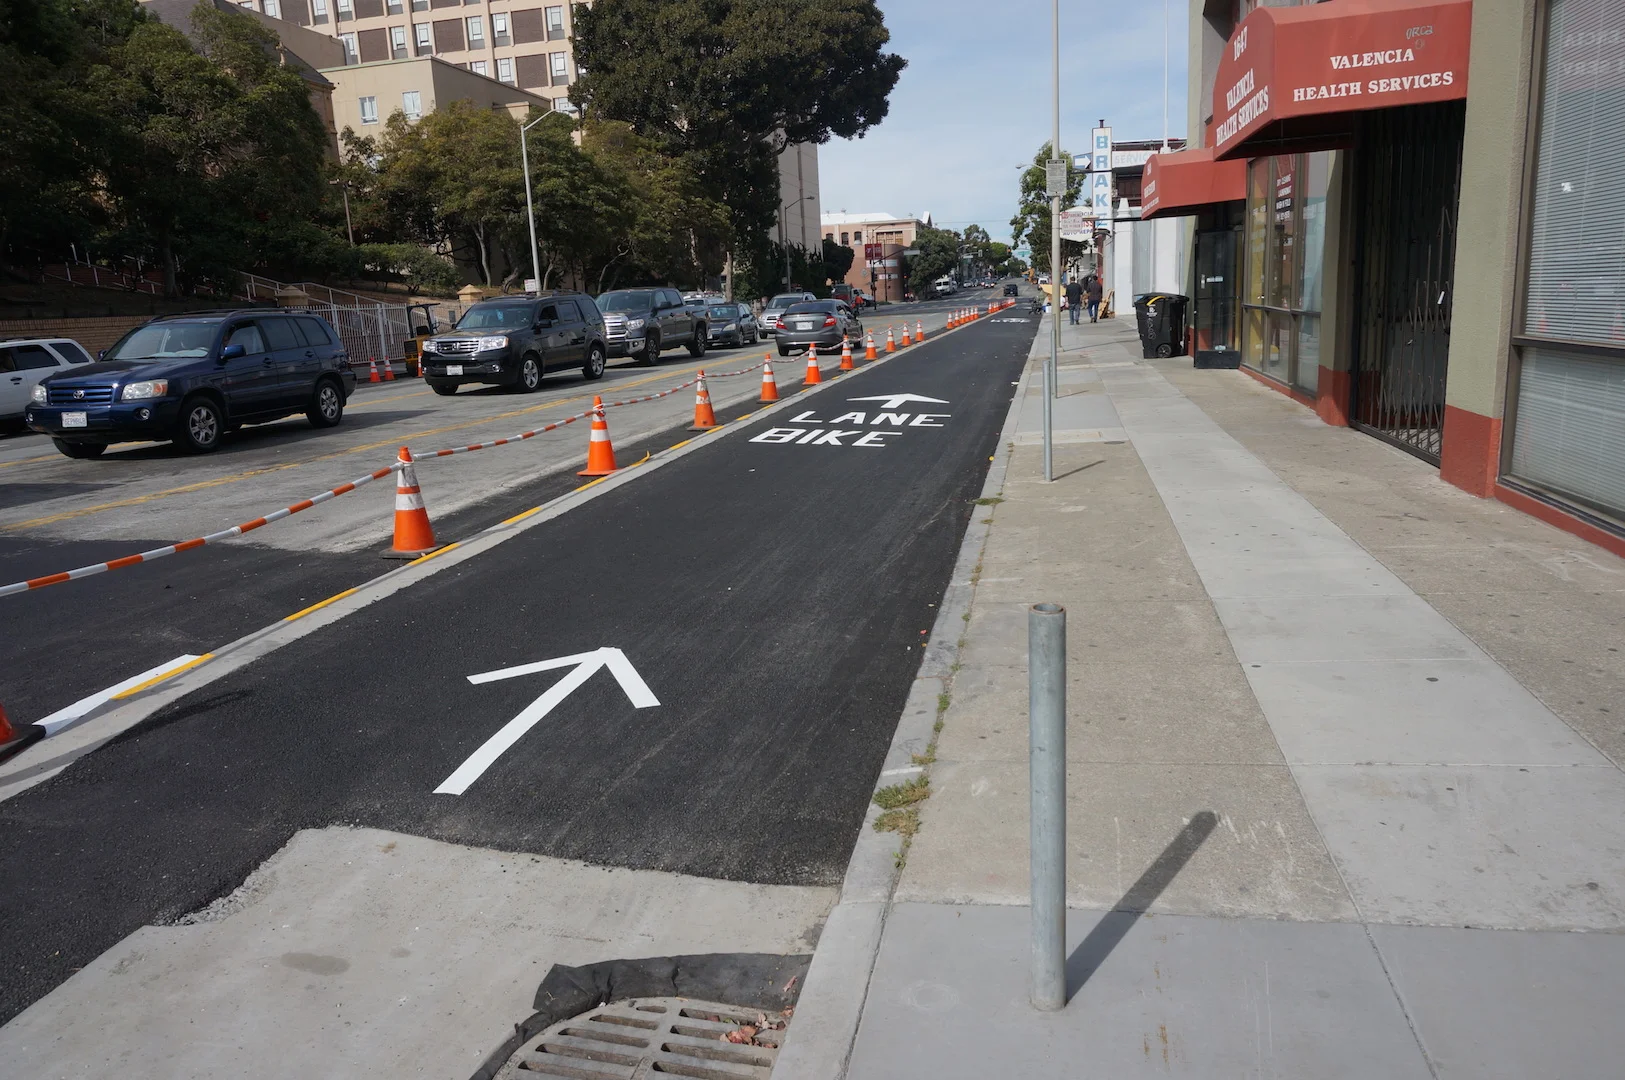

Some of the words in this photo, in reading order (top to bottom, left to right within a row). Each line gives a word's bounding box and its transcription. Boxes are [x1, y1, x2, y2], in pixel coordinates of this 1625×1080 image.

[1233, 25, 1248, 61] 1647
[1330, 48, 1415, 70] VALENCIA
[1226, 68, 1255, 112] VALENCIA
[1293, 81, 1362, 102] HEALTH
[1367, 71, 1454, 94] SERVICES
[1216, 112, 1238, 147] HEALTH
[1238, 85, 1269, 130] SERVICES
[1115, 152, 1148, 165] SERVIC
[1095, 136, 1109, 226] BRAKE
[789, 411, 951, 427] LANE
[748, 427, 903, 447] BIKE
